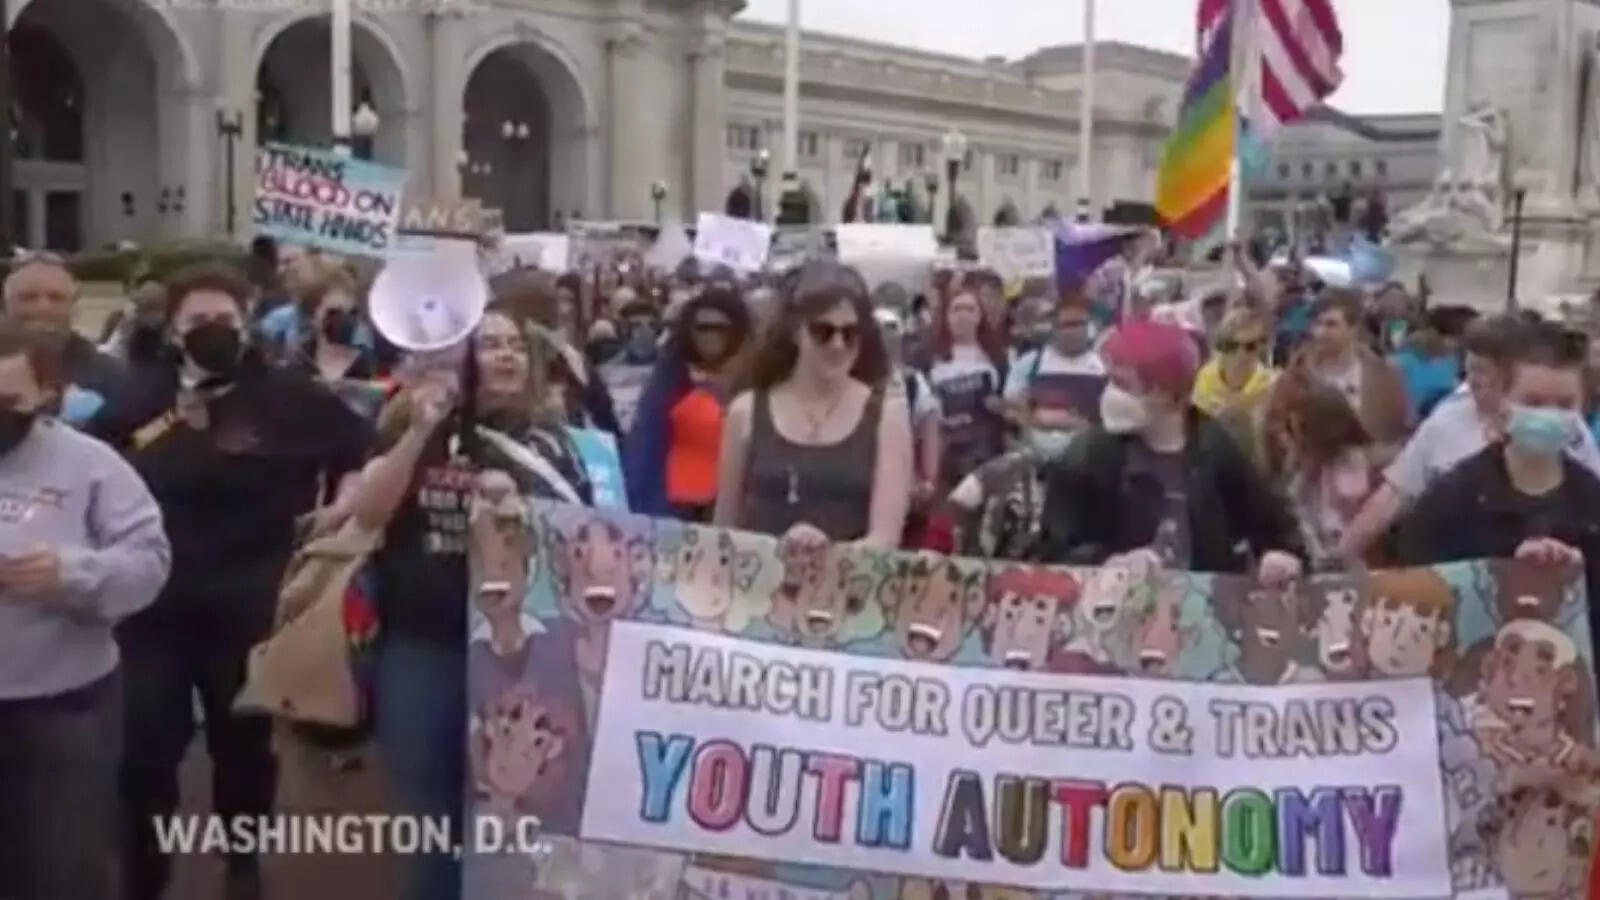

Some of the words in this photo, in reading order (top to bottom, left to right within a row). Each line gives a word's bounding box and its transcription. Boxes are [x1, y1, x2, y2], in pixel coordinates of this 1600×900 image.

[262, 165, 349, 207] BLOOD
[355, 188, 394, 215] ON
[643, 640, 833, 723] MARCH
[845, 670, 951, 737] FOR
[961, 682, 1135, 751] QUEER
[1147, 695, 1195, 756] &
[1208, 698, 1398, 759] TRANS
[634, 730, 914, 852] YOUTH
[932, 768, 1403, 877] AUTONOMY
